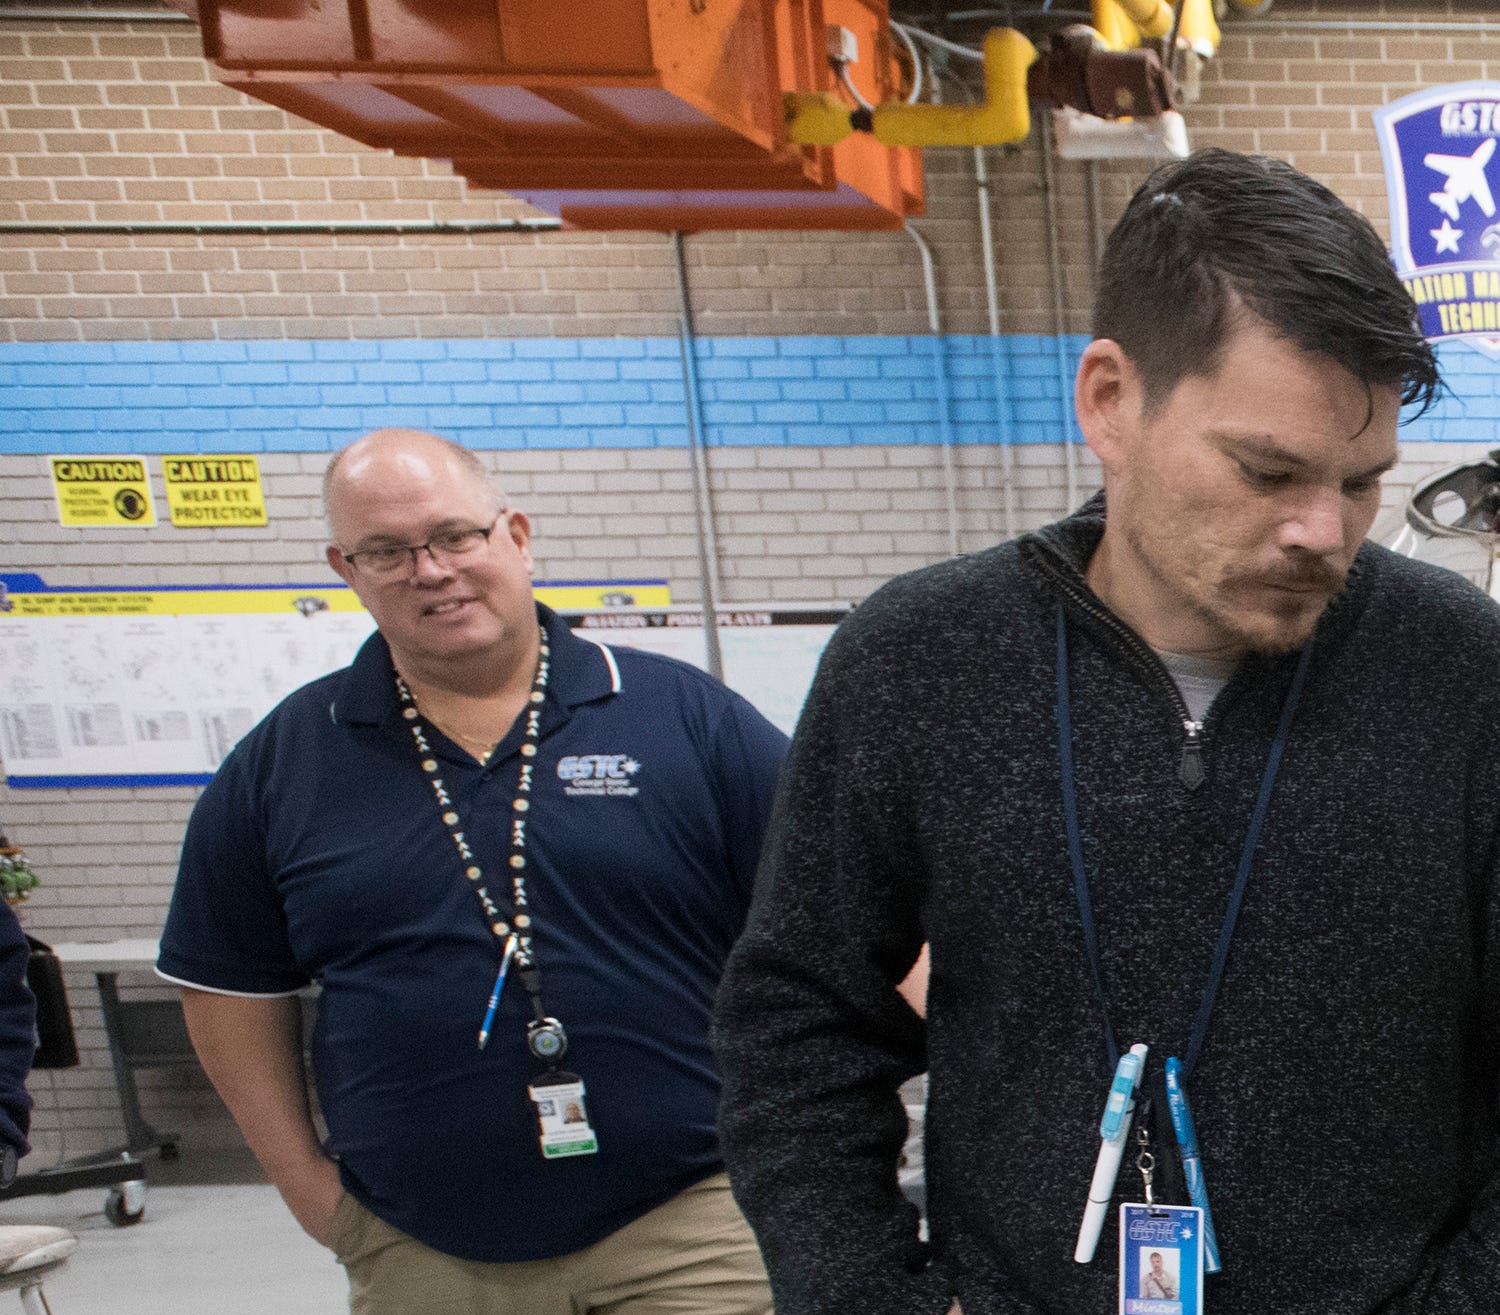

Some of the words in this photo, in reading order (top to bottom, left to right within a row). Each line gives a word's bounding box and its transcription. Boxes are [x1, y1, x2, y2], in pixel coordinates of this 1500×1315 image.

[1404, 272, 1467, 304] IATION
[57, 463, 145, 481] CAUTION
[169, 462, 255, 481] CAUTION
[180, 490, 219, 501] WEAR
[224, 490, 249, 501] EYE
[174, 507, 263, 519] PROTECTION
[557, 754, 628, 779] GSTC
[1128, 1219, 1181, 1242] GSTC
